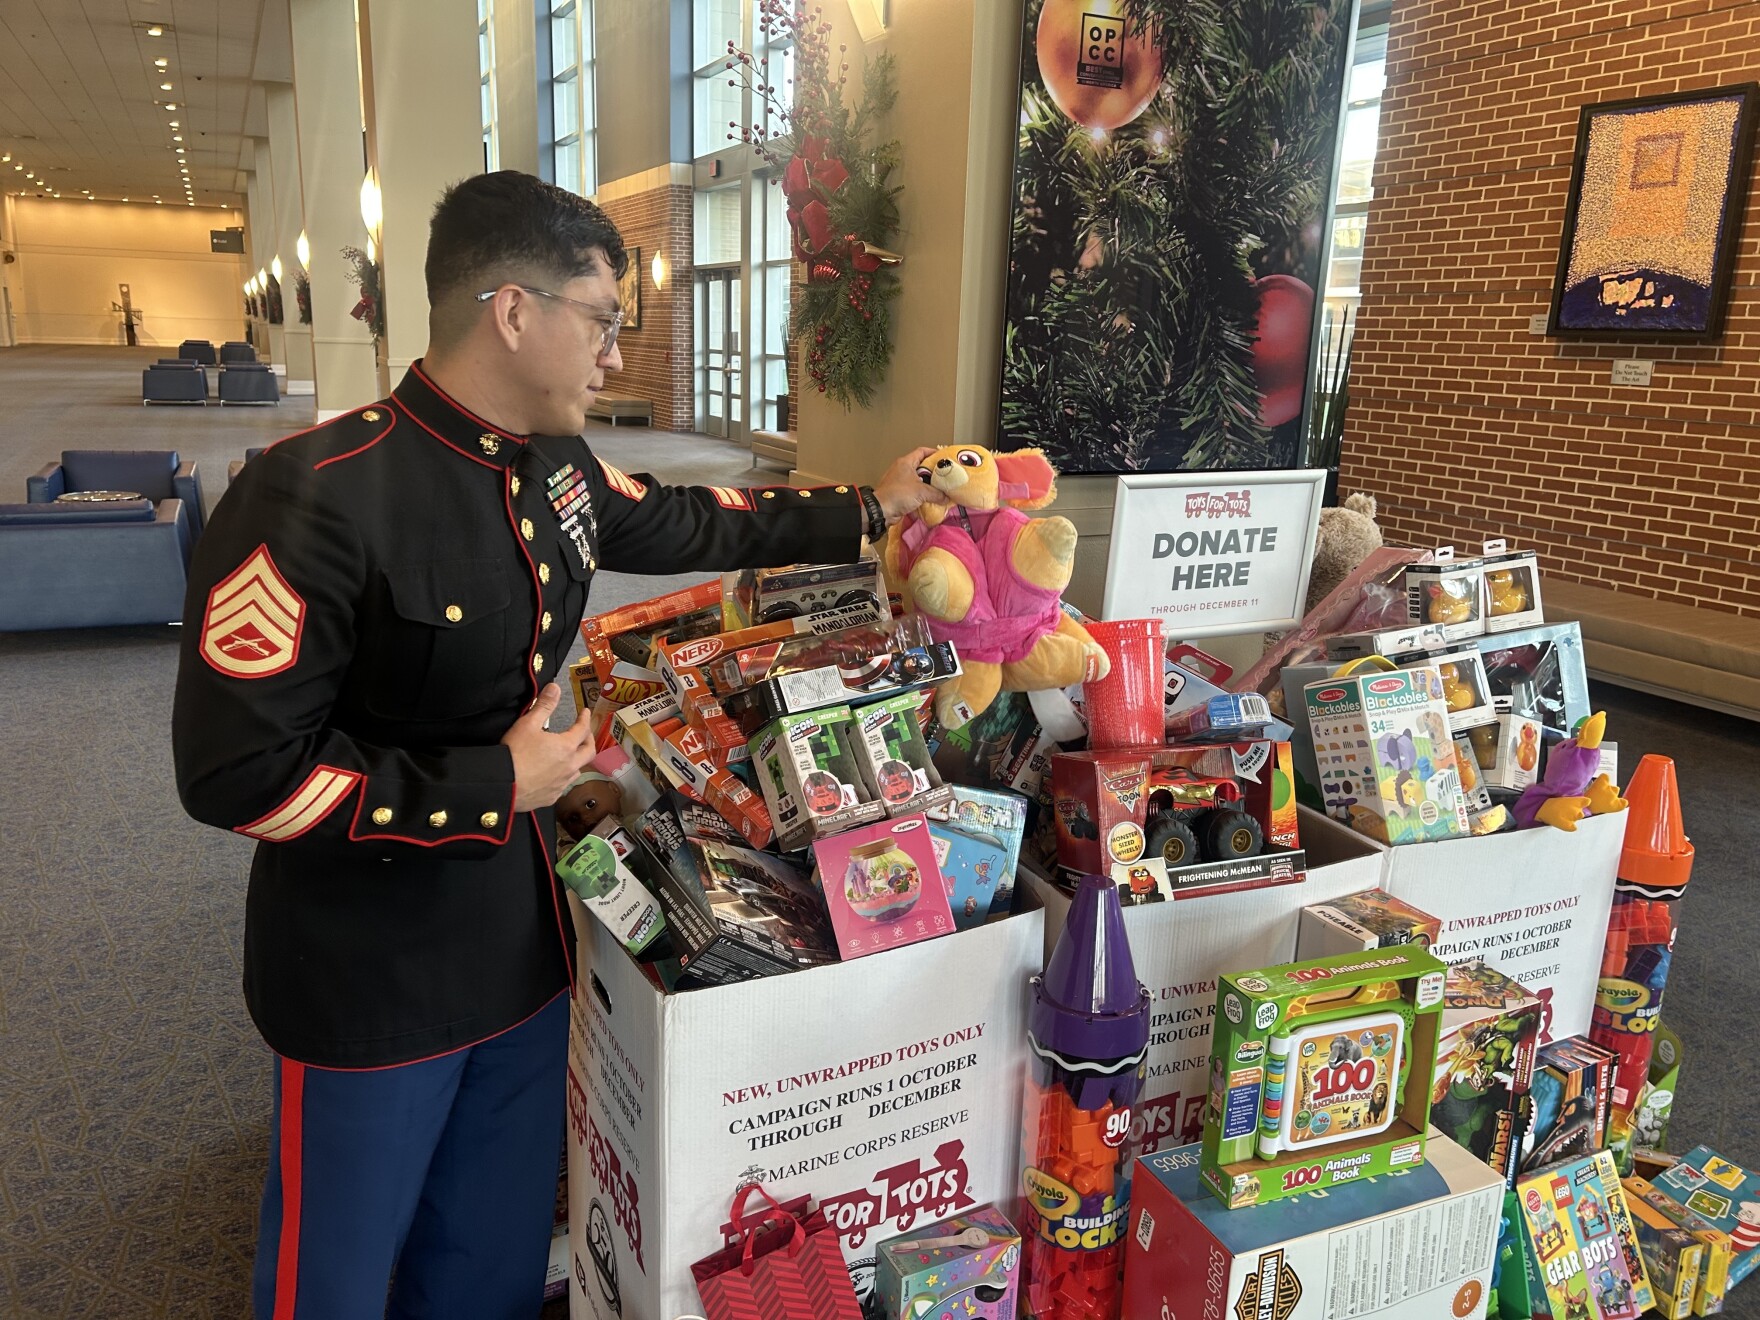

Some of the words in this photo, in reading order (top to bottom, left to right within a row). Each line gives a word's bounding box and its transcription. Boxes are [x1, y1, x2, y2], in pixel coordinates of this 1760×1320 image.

[1187, 496, 1207, 510] TOYS
[1208, 498, 1225, 511] FOR
[1228, 498, 1248, 512] TOTS
[1152, 527, 1278, 559] DONATE
[1171, 561, 1251, 591] HERE
[808, 613, 840, 622] STAR
[839, 603, 869, 614] WARS
[1151, 604, 1197, 615] THROUGH
[1199, 599, 1248, 611] DECEMBER
[1251, 598, 1259, 607] 11
[812, 611, 879, 635] MANDALORIAN
[672, 640, 719, 667] NERF
[634, 698, 656, 710] STAR
[656, 691, 671, 701] WAR
[889, 698, 909, 708] CREEPER
[1308, 701, 1361, 717] Blockables
[1365, 692, 1428, 710] Blockables
[1386, 708, 1397, 716] Play
[790, 718, 816, 736] ICON
[817, 712, 838, 721] CREEPER
[863, 706, 887, 727] ICON
[1371, 720, 1386, 733] 34
[1012, 736, 1036, 773] SENTINEL
[1239, 754, 1255, 769] PUSH
[1253, 745, 1261, 756] ME
[670, 756, 696, 784] 8+
[891, 798, 924, 815] MINECRAFT
[1117, 791, 1141, 804] TOON
[659, 810, 682, 838] FAST
[689, 804, 724, 821] FAST
[817, 812, 852, 827] MINECRAFT
[647, 808, 680, 851] FURIOUS
[1115, 844, 1140, 857] WHEELS!
[1118, 839, 1135, 849] SIZED
[1178, 868, 1229, 883] FRIGHTENING
[1230, 864, 1262, 876] McMEAN
[620, 900, 641, 922] CREEPER
[1316, 910, 1364, 935] POSEABLE
[1448, 908, 1522, 932] UNWRAPPED
[1523, 902, 1552, 919] TOYS
[1553, 895, 1581, 912] ONLY
[634, 911, 658, 944] ICON
[680, 928, 690, 938] NOS
[699, 924, 713, 939] ESCAPE
[1432, 938, 1481, 957] MPAIGN
[1482, 932, 1513, 949] RUNS
[1515, 931, 1520, 942] 1
[1522, 918, 1572, 940] OCTOBER
[1500, 937, 1560, 961] DECEMBER
[1285, 967, 1332, 985] 100
[1330, 959, 1378, 976] Animals
[1379, 955, 1408, 967] Book
[1517, 963, 1561, 984] RESERVE
[1161, 980, 1217, 1000] UNWRA
[1596, 985, 1640, 997] Crayola
[1226, 996, 1240, 1011] Leap
[1226, 1006, 1242, 1021] Frog
[1257, 1004, 1275, 1019] Leap
[1150, 1007, 1203, 1028] MPAIGN
[1258, 1013, 1276, 1027] Frog
[1592, 1007, 1659, 1033] BLOC
[1148, 1023, 1211, 1046] HROUGH
[625, 1057, 646, 1093] ONLY
[721, 1083, 772, 1107] NEW,
[776, 1052, 892, 1094] UNWRAPPED
[896, 1037, 939, 1062] TOYS
[942, 1022, 986, 1047] ONLY
[1147, 1055, 1205, 1078] MARINE
[1600, 1065, 1608, 1086] BITE
[609, 1061, 643, 1121] OCTOBER
[1312, 1059, 1376, 1101] 100
[600, 1063, 636, 1132] DECEMBER
[728, 1096, 832, 1135] CAMPAIGN
[836, 1081, 883, 1108] RUNS
[887, 1078, 894, 1093] 1
[899, 1053, 977, 1088] OCTOBER
[1312, 1094, 1349, 1109] ANIMALS
[1350, 1091, 1373, 1101] BOOK
[1599, 1091, 1607, 1100] &
[747, 1114, 843, 1152] THROUGH
[868, 1078, 962, 1119] DECEMBER
[1106, 1108, 1131, 1138] 90
[1596, 1102, 1605, 1132] BASH
[611, 1122, 641, 1174] RESERVE
[768, 1150, 840, 1183] MARINE
[843, 1133, 897, 1161] CORPS
[900, 1109, 970, 1143] RESERVE
[1488, 1112, 1512, 1173] WARS!
[1281, 1165, 1322, 1192] 100
[1324, 1152, 1372, 1172] Animals
[1507, 1139, 1518, 1182] STEGOSAURUS
[1576, 1166, 1591, 1177] CREATE
[1600, 1157, 1608, 1165] 62
[589, 1131, 608, 1179] FOR
[611, 1172, 639, 1236] TOTS
[1332, 1166, 1360, 1182] Book
[1027, 1175, 1064, 1200] Crayola
[1555, 1186, 1570, 1200] LEGO
[823, 1199, 875, 1232] FOR
[891, 1169, 959, 1207] TOTS
[1063, 1203, 1131, 1229] BUILDING
[1027, 1207, 1129, 1249] BLOCKS
[1546, 1250, 1582, 1285] GEAR
[1581, 1236, 1617, 1270] BOTS
[1276, 1271, 1295, 1319] CYCLES
